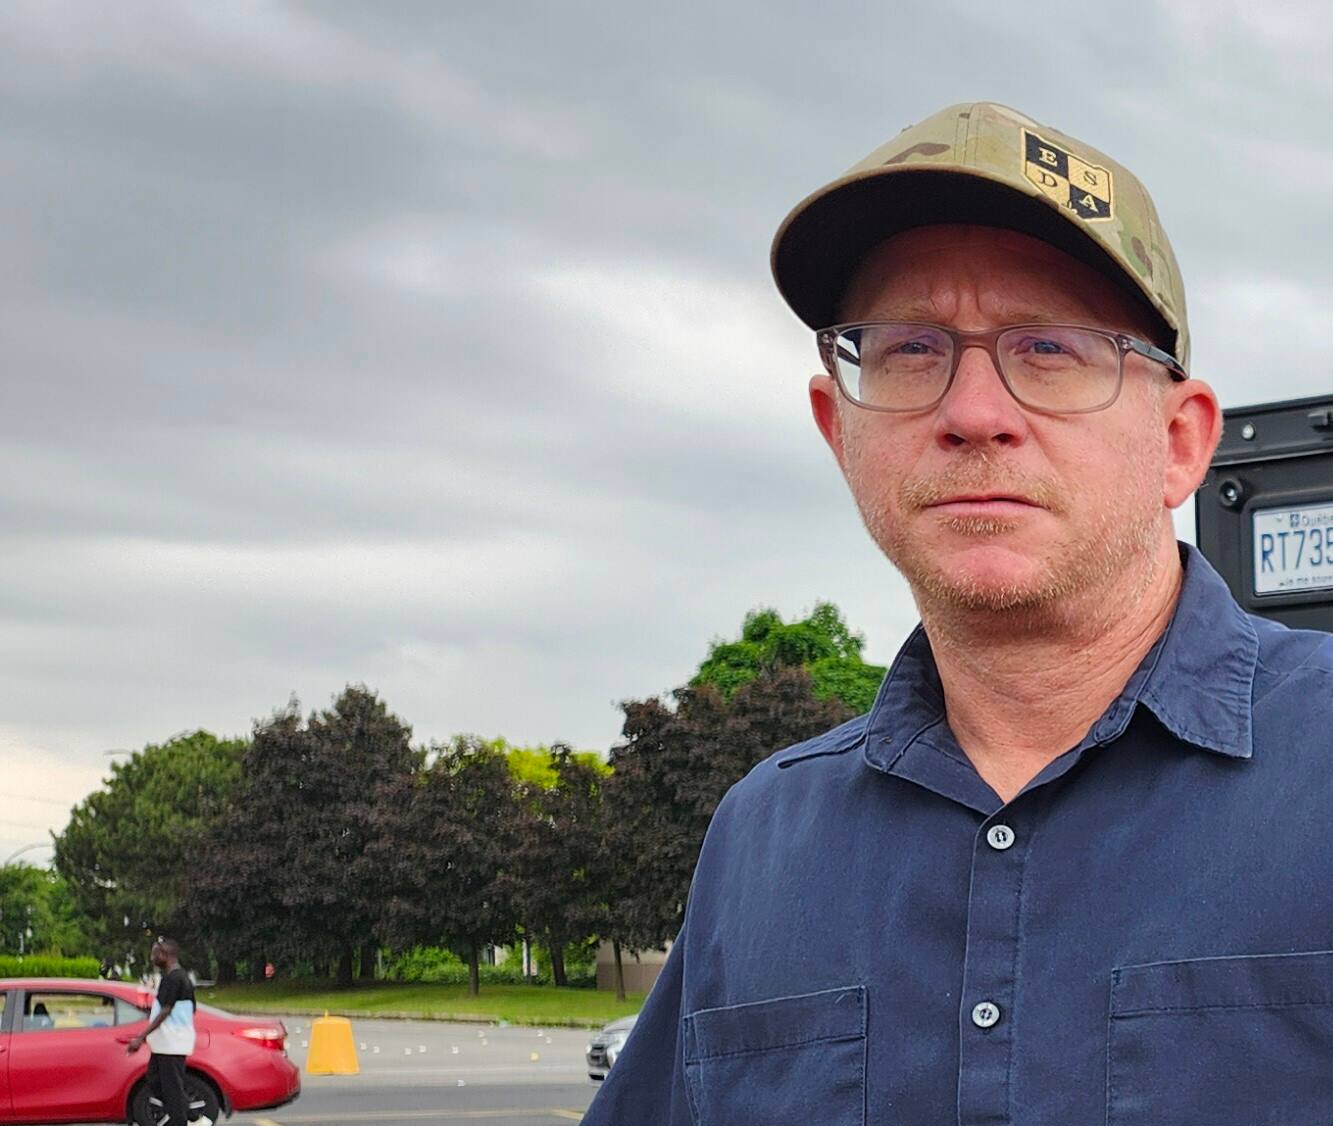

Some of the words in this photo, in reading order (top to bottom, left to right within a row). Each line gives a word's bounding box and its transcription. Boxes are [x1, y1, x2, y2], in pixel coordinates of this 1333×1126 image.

[1039, 147, 1058, 167] E
[1084, 170, 1098, 186] S
[1038, 170, 1058, 188] D
[1079, 194, 1099, 213] A
